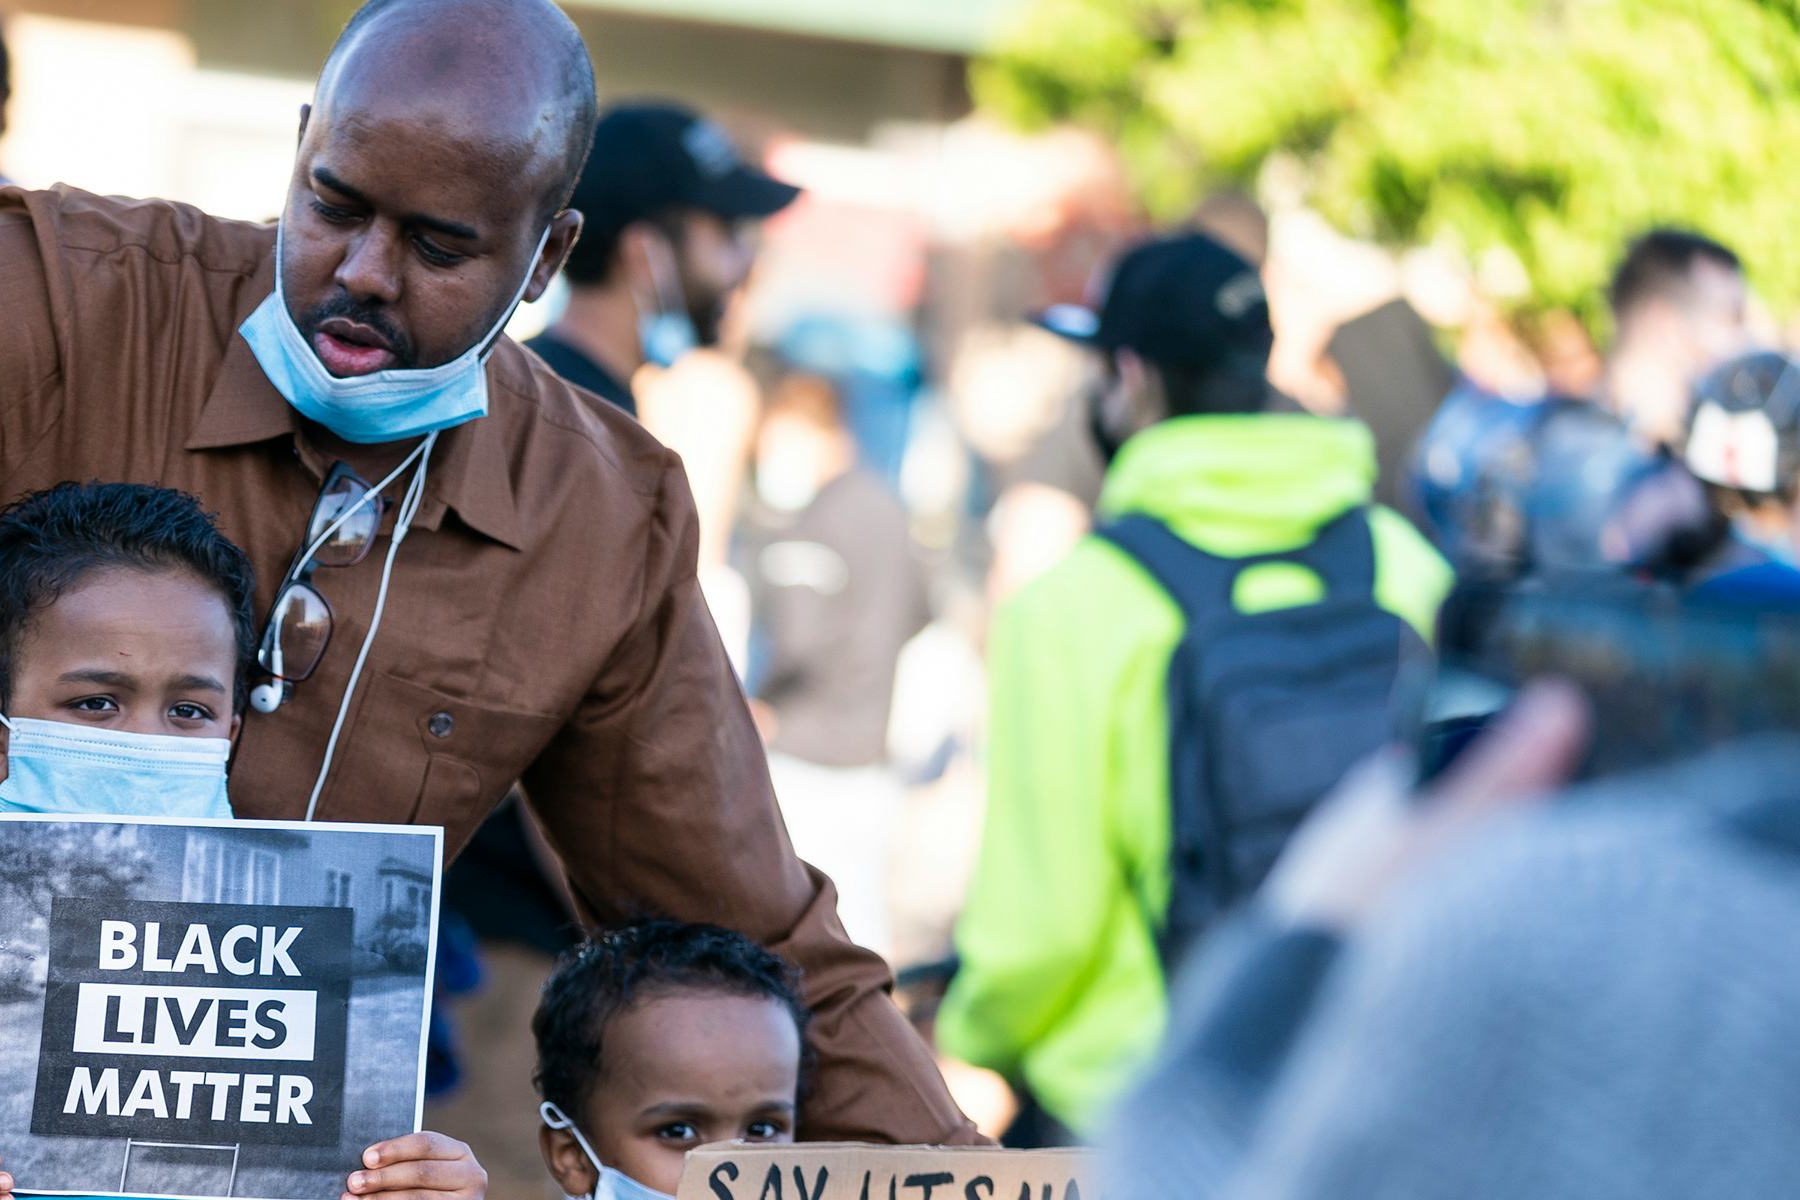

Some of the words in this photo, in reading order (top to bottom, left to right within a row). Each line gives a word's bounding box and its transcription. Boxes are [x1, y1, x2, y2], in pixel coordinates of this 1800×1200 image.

[100, 919, 304, 977] BLACK
[102, 994, 288, 1050] LIVES
[62, 1065, 314, 1125] MATTER
